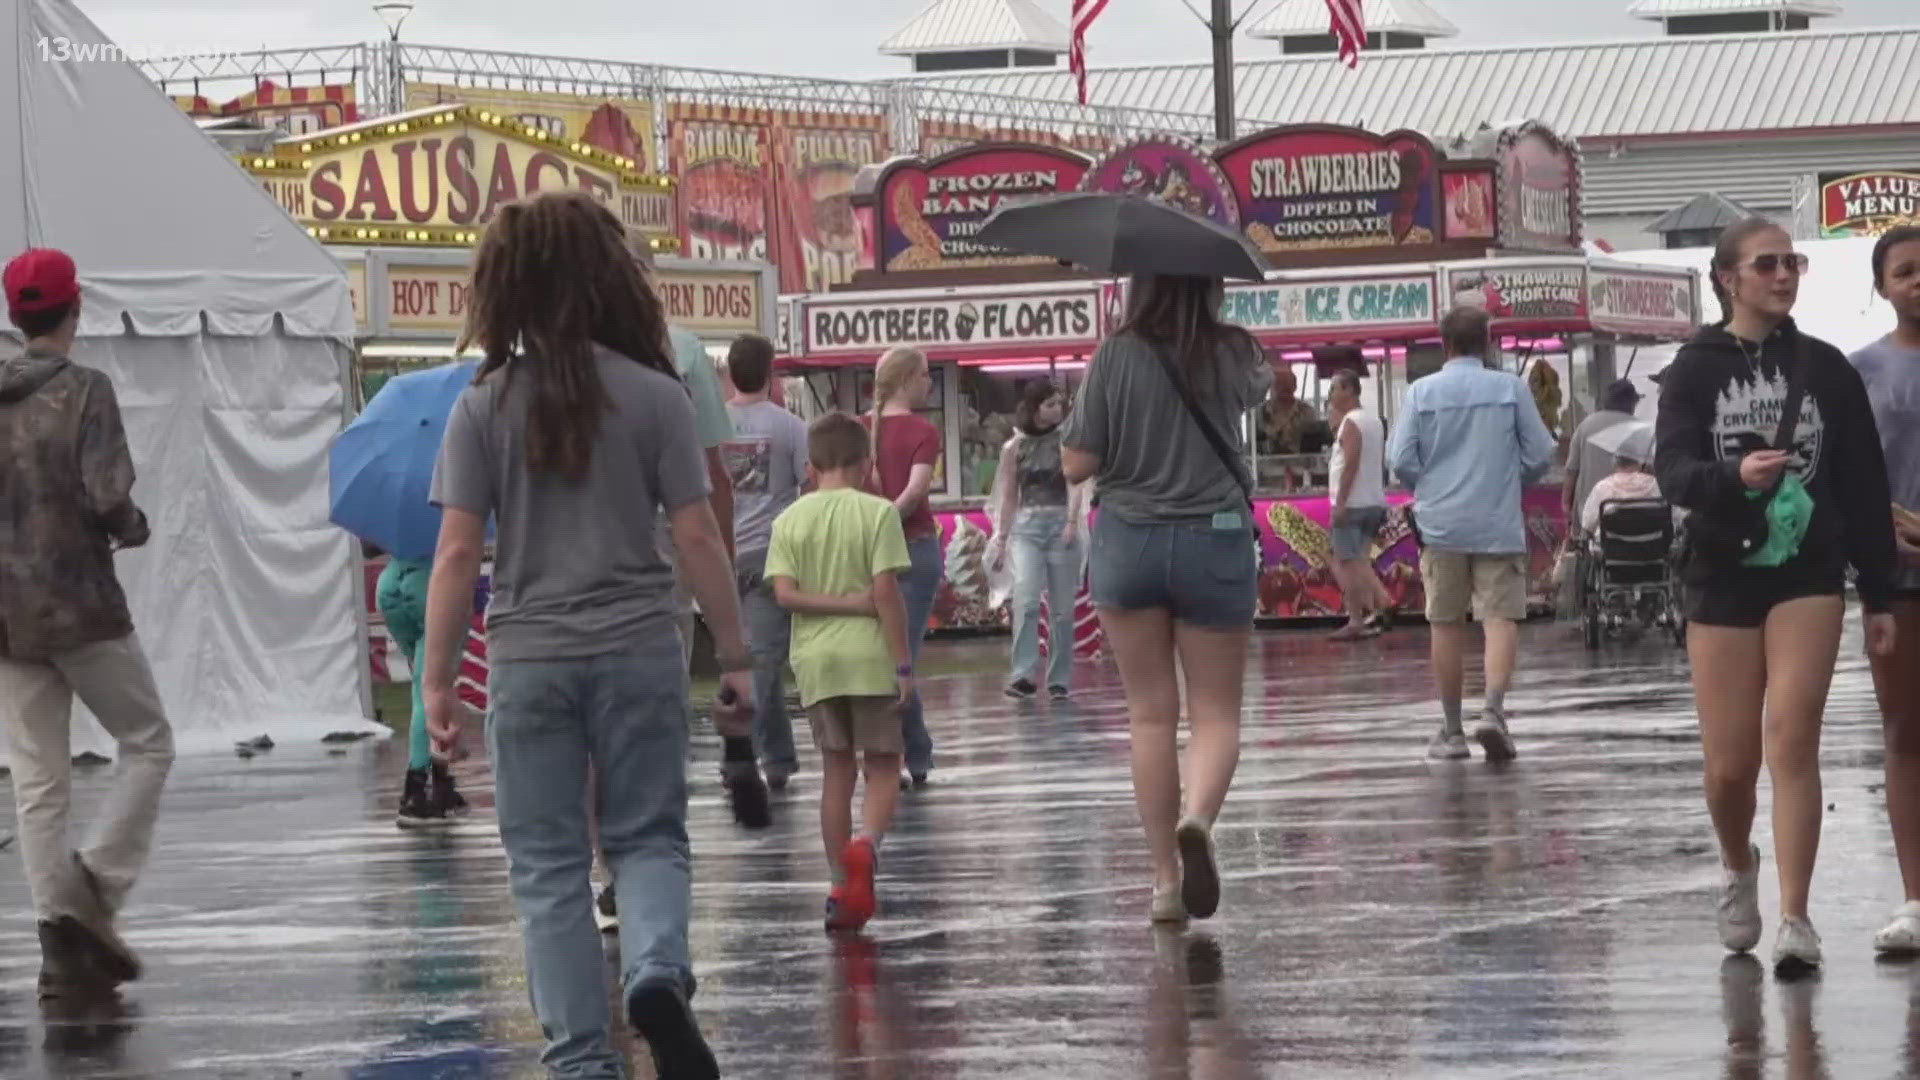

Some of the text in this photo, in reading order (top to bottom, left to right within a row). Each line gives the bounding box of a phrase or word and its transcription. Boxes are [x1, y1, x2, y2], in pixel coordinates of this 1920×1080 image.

[928, 170, 1058, 193] FROZEN
[1251, 150, 1401, 197] STRAWBERRIES
[1839, 177, 1920, 199] VALUE
[1283, 199, 1377, 217] DIPPED IN
[1845, 196, 1914, 218] MENU
[1274, 217, 1388, 236] CHOCOLATE
[1493, 270, 1582, 290] STRAWBERRY
[393, 280, 439, 316] HOT
[703, 284, 752, 318] DOGS
[1222, 289, 1281, 325] ERVE
[1305, 287, 1341, 322] ICE
[1348, 283, 1428, 321] CREAM
[1500, 286, 1580, 305] SHORTCAKE
[815, 307, 950, 346] ROOTBEER
[983, 300, 1090, 338] FLOATS
[1749, 399, 1781, 414] CAM
